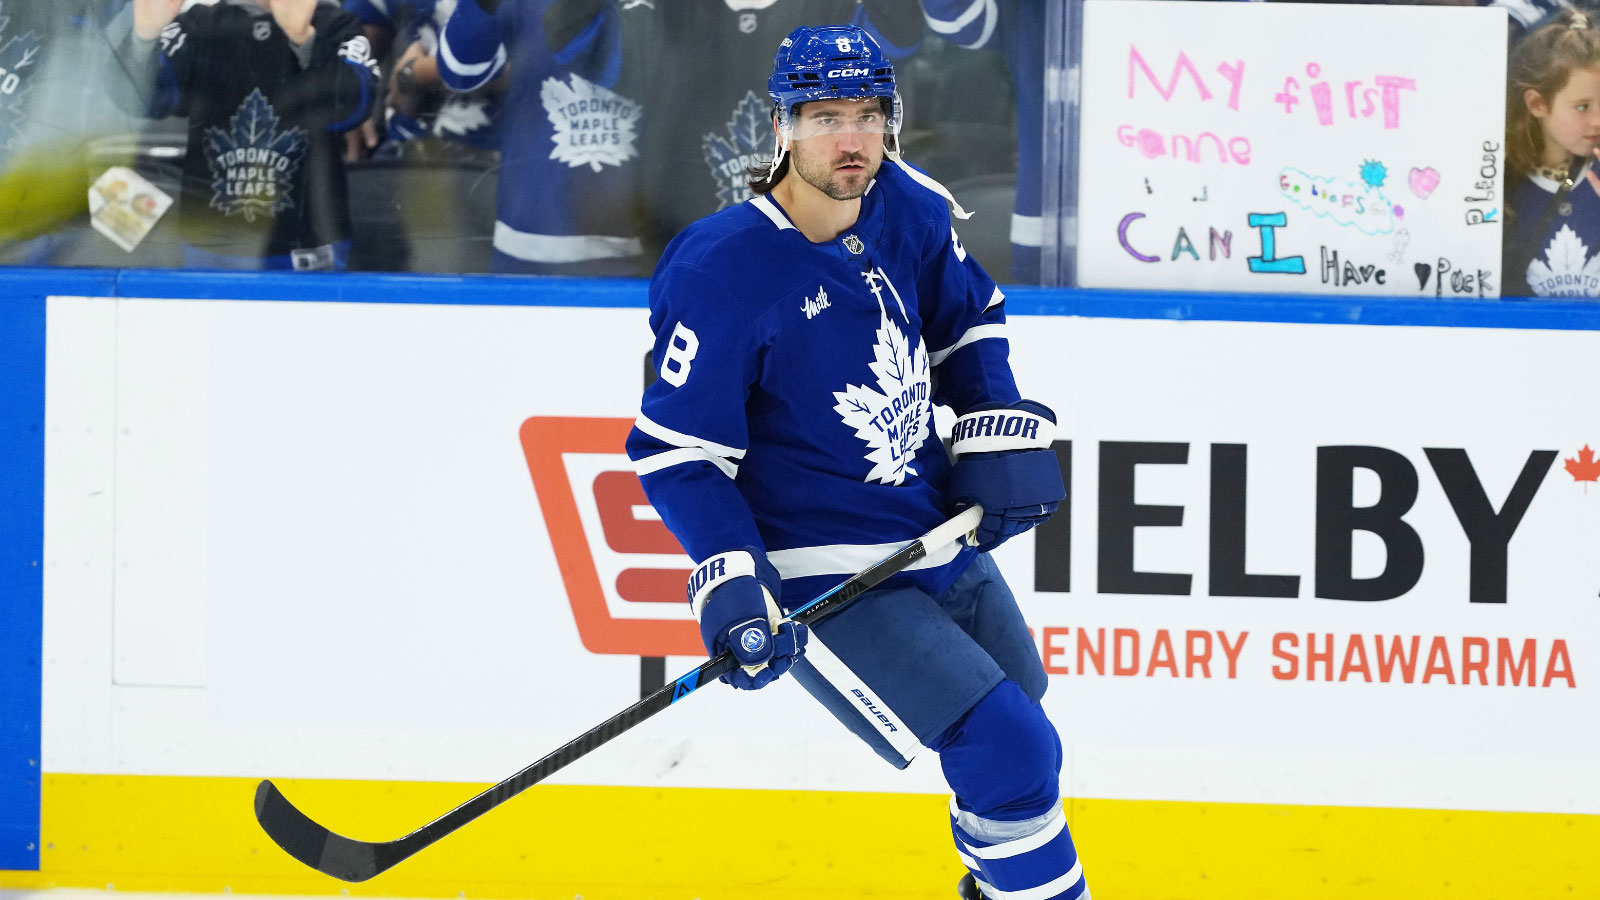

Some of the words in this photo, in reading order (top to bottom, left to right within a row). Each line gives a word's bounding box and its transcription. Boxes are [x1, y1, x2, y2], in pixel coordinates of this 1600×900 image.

[835, 37, 851, 53] 8
[827, 68, 870, 79] CCM
[558, 98, 632, 120] TORONTO
[570, 118, 619, 131] MAPLE
[570, 132, 620, 147] LEAFS
[217, 147, 290, 172] TORONTO
[226, 167, 276, 182] MAPLE
[226, 182, 276, 197] LEAFS
[1117, 212, 1233, 263] CAN
[1247, 212, 1306, 274] I
[1539, 274, 1599, 292] TORONTO
[660, 320, 700, 388] 8
[869, 382, 927, 433] TORONTO
[890, 420, 920, 462] LEFS
[1028, 626, 1249, 679] ENDARY
[1271, 631, 1577, 688] SHAWARMA
